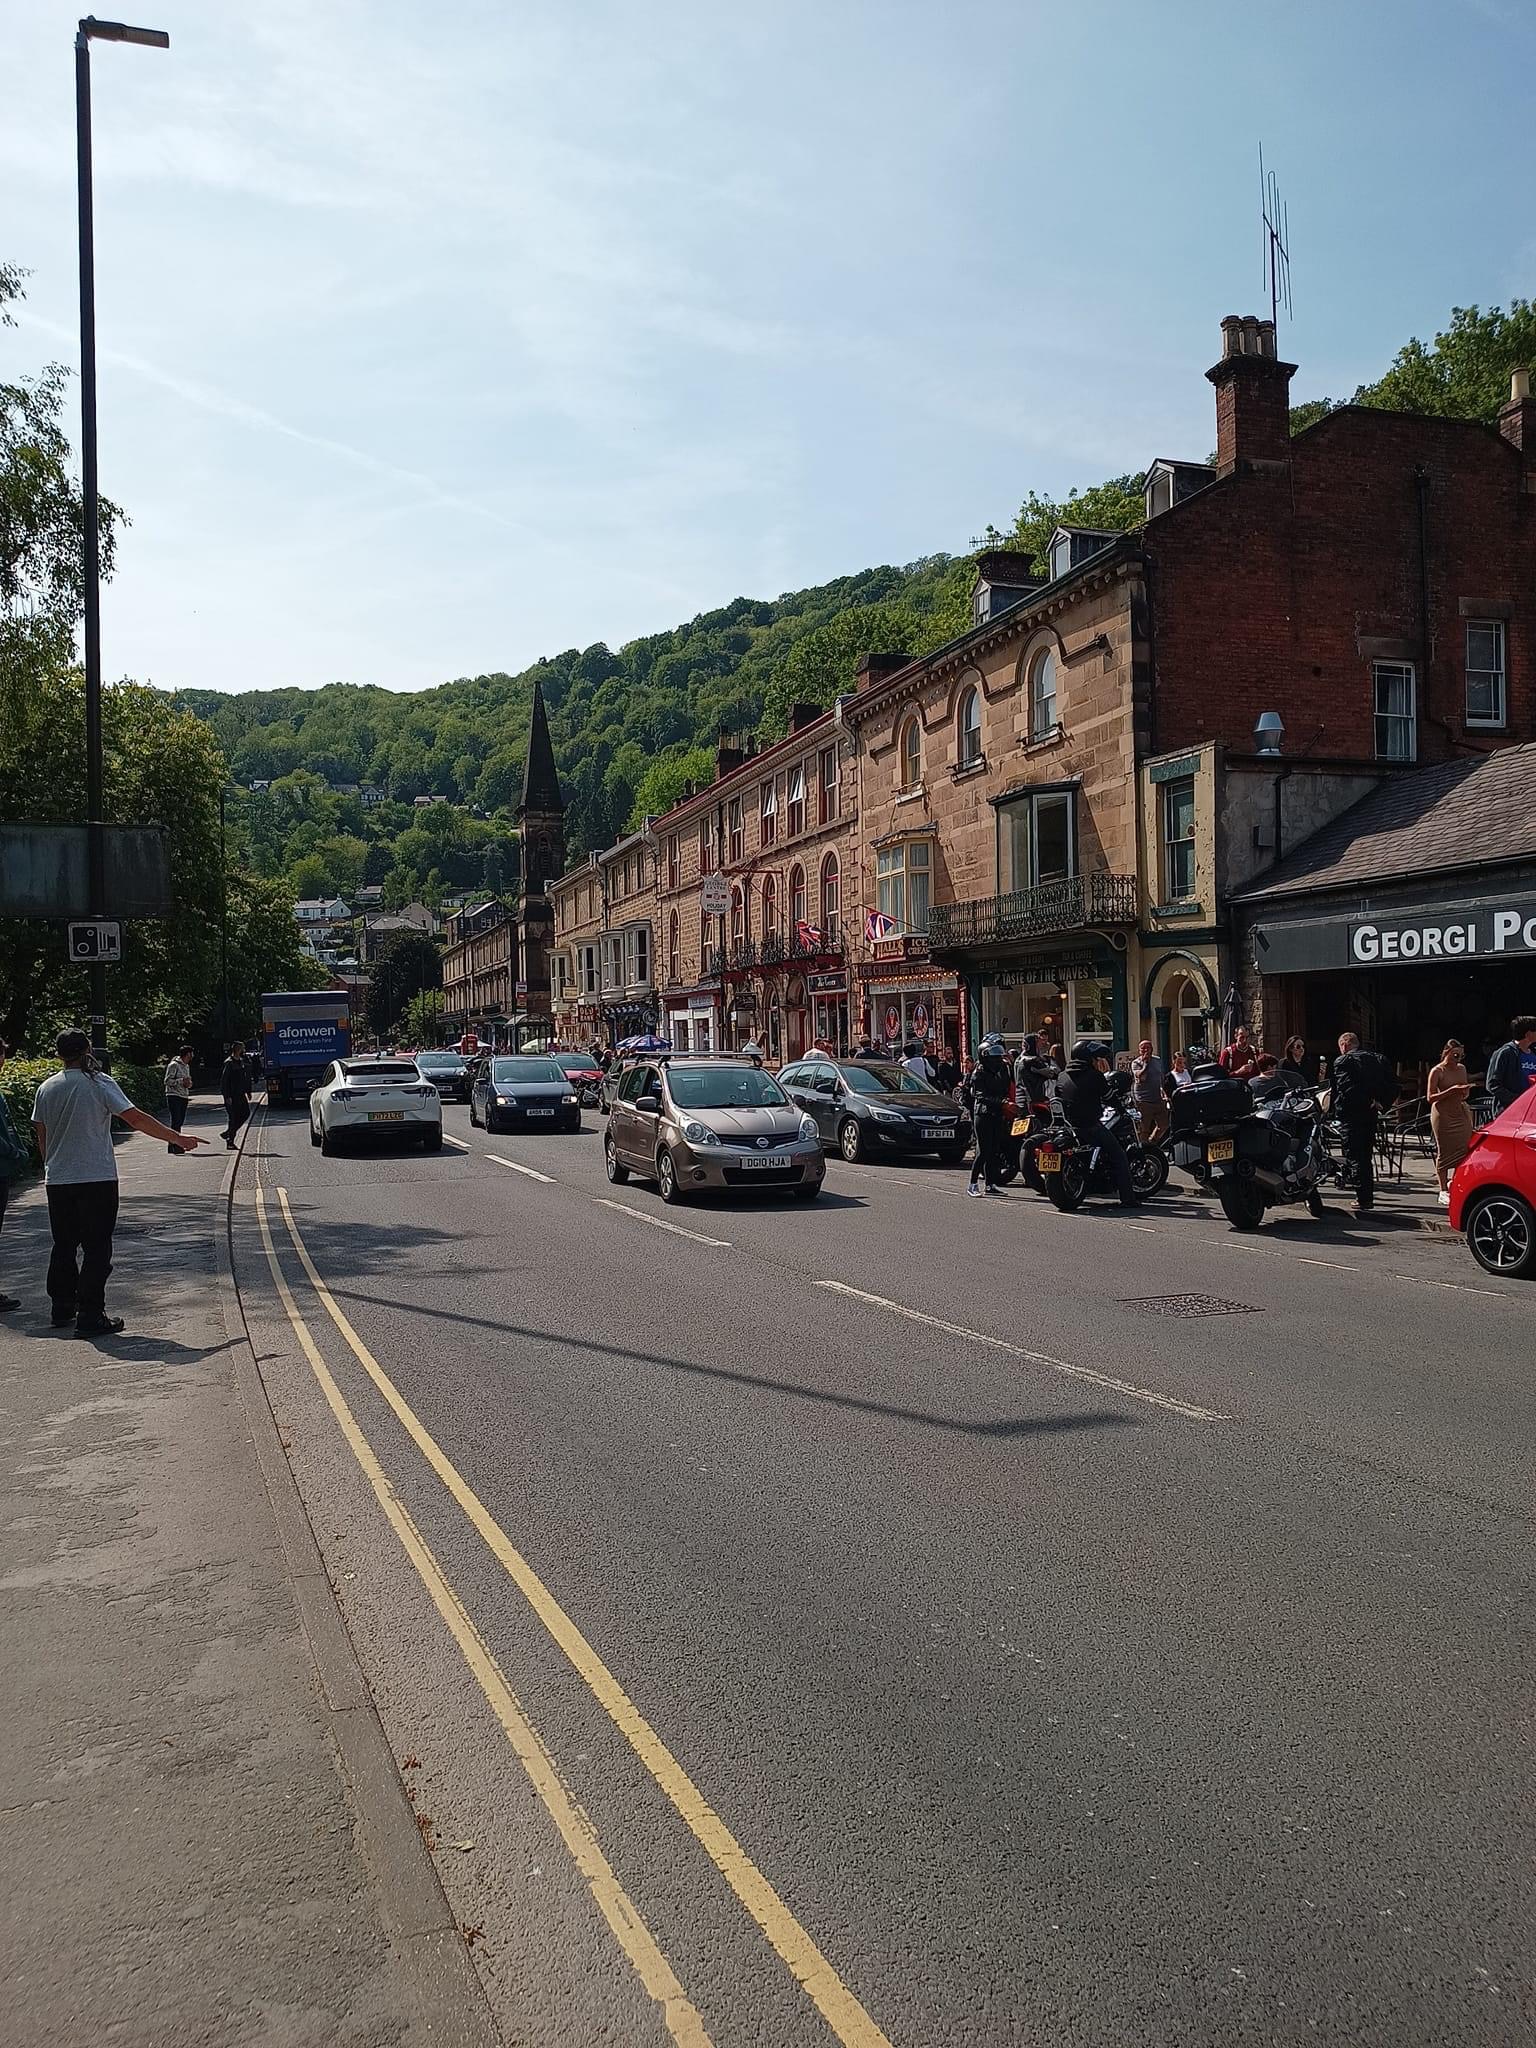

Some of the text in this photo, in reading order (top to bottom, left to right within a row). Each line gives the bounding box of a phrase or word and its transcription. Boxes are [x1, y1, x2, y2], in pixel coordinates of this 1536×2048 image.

[911, 939, 928, 947] ICE
[1353, 924, 1476, 961] GEORGI
[860, 966, 872, 976] ICE
[873, 964, 898, 975] CREAM
[1001, 964, 1089, 986] TASTE OF THE WAVES
[278, 1026, 336, 1038] afonwen
[747, 1157, 786, 1168] DG10 HJA
[1042, 1153, 1059, 1161] FX10
